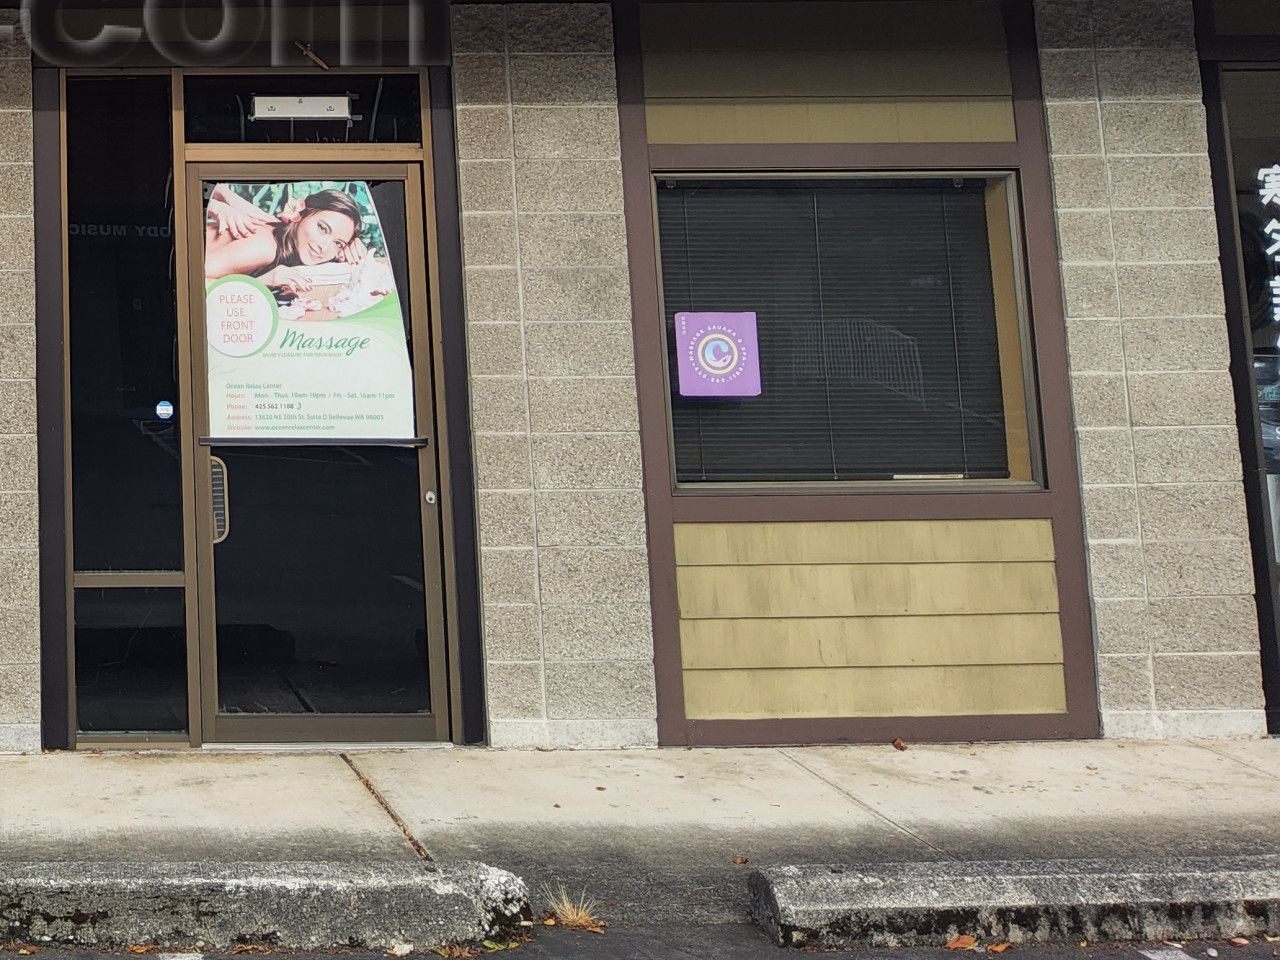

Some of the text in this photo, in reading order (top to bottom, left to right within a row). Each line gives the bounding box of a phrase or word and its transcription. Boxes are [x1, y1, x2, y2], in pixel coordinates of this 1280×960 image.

[219, 294, 254, 304] PLEASE
[226, 307, 246, 317] USE
[221, 320, 254, 330] FRONT
[223, 333, 254, 343] DOOR
[279, 328, 371, 356] Massage
